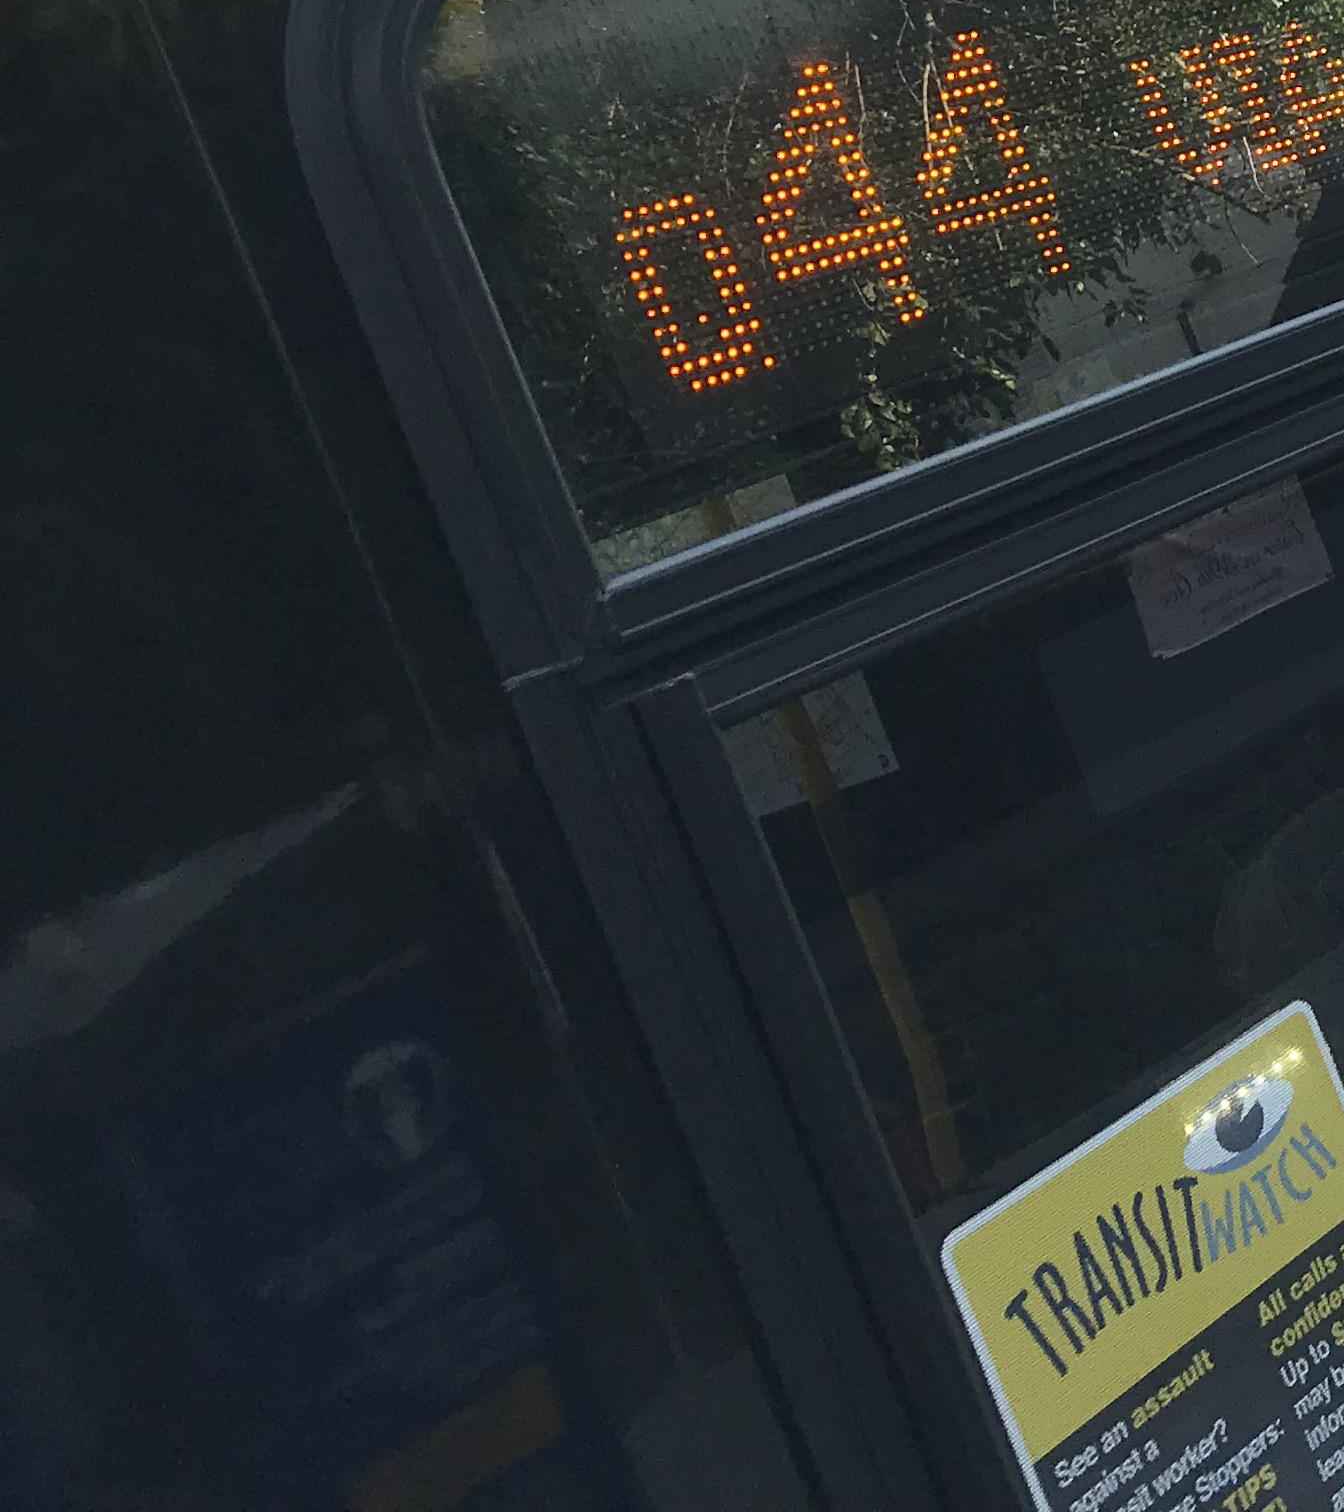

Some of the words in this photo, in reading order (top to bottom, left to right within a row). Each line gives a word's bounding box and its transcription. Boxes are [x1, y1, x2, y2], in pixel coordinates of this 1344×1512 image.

[615, 29, 1074, 391] Q44
[1004, 1175, 1204, 1377] TRANSIT
[1201, 1123, 1338, 1264] WATCH
[1258, 1288, 1287, 1328] All
[1290, 1255, 1337, 1300] calls
[1279, 1357, 1309, 1388] Up
[1308, 1340, 1330, 1365] to
[1293, 1376, 1332, 1420] may
[1054, 1445, 1100, 1488] See
[1100, 1420, 1130, 1454] an
[1130, 1349, 1215, 1429] assault
[1152, 1417, 1228, 1497] worker?
[1069, 1448, 1145, 1512] against
[1143, 1439, 1161, 1462] a
[1195, 1418, 1285, 1503] Stoppers:
